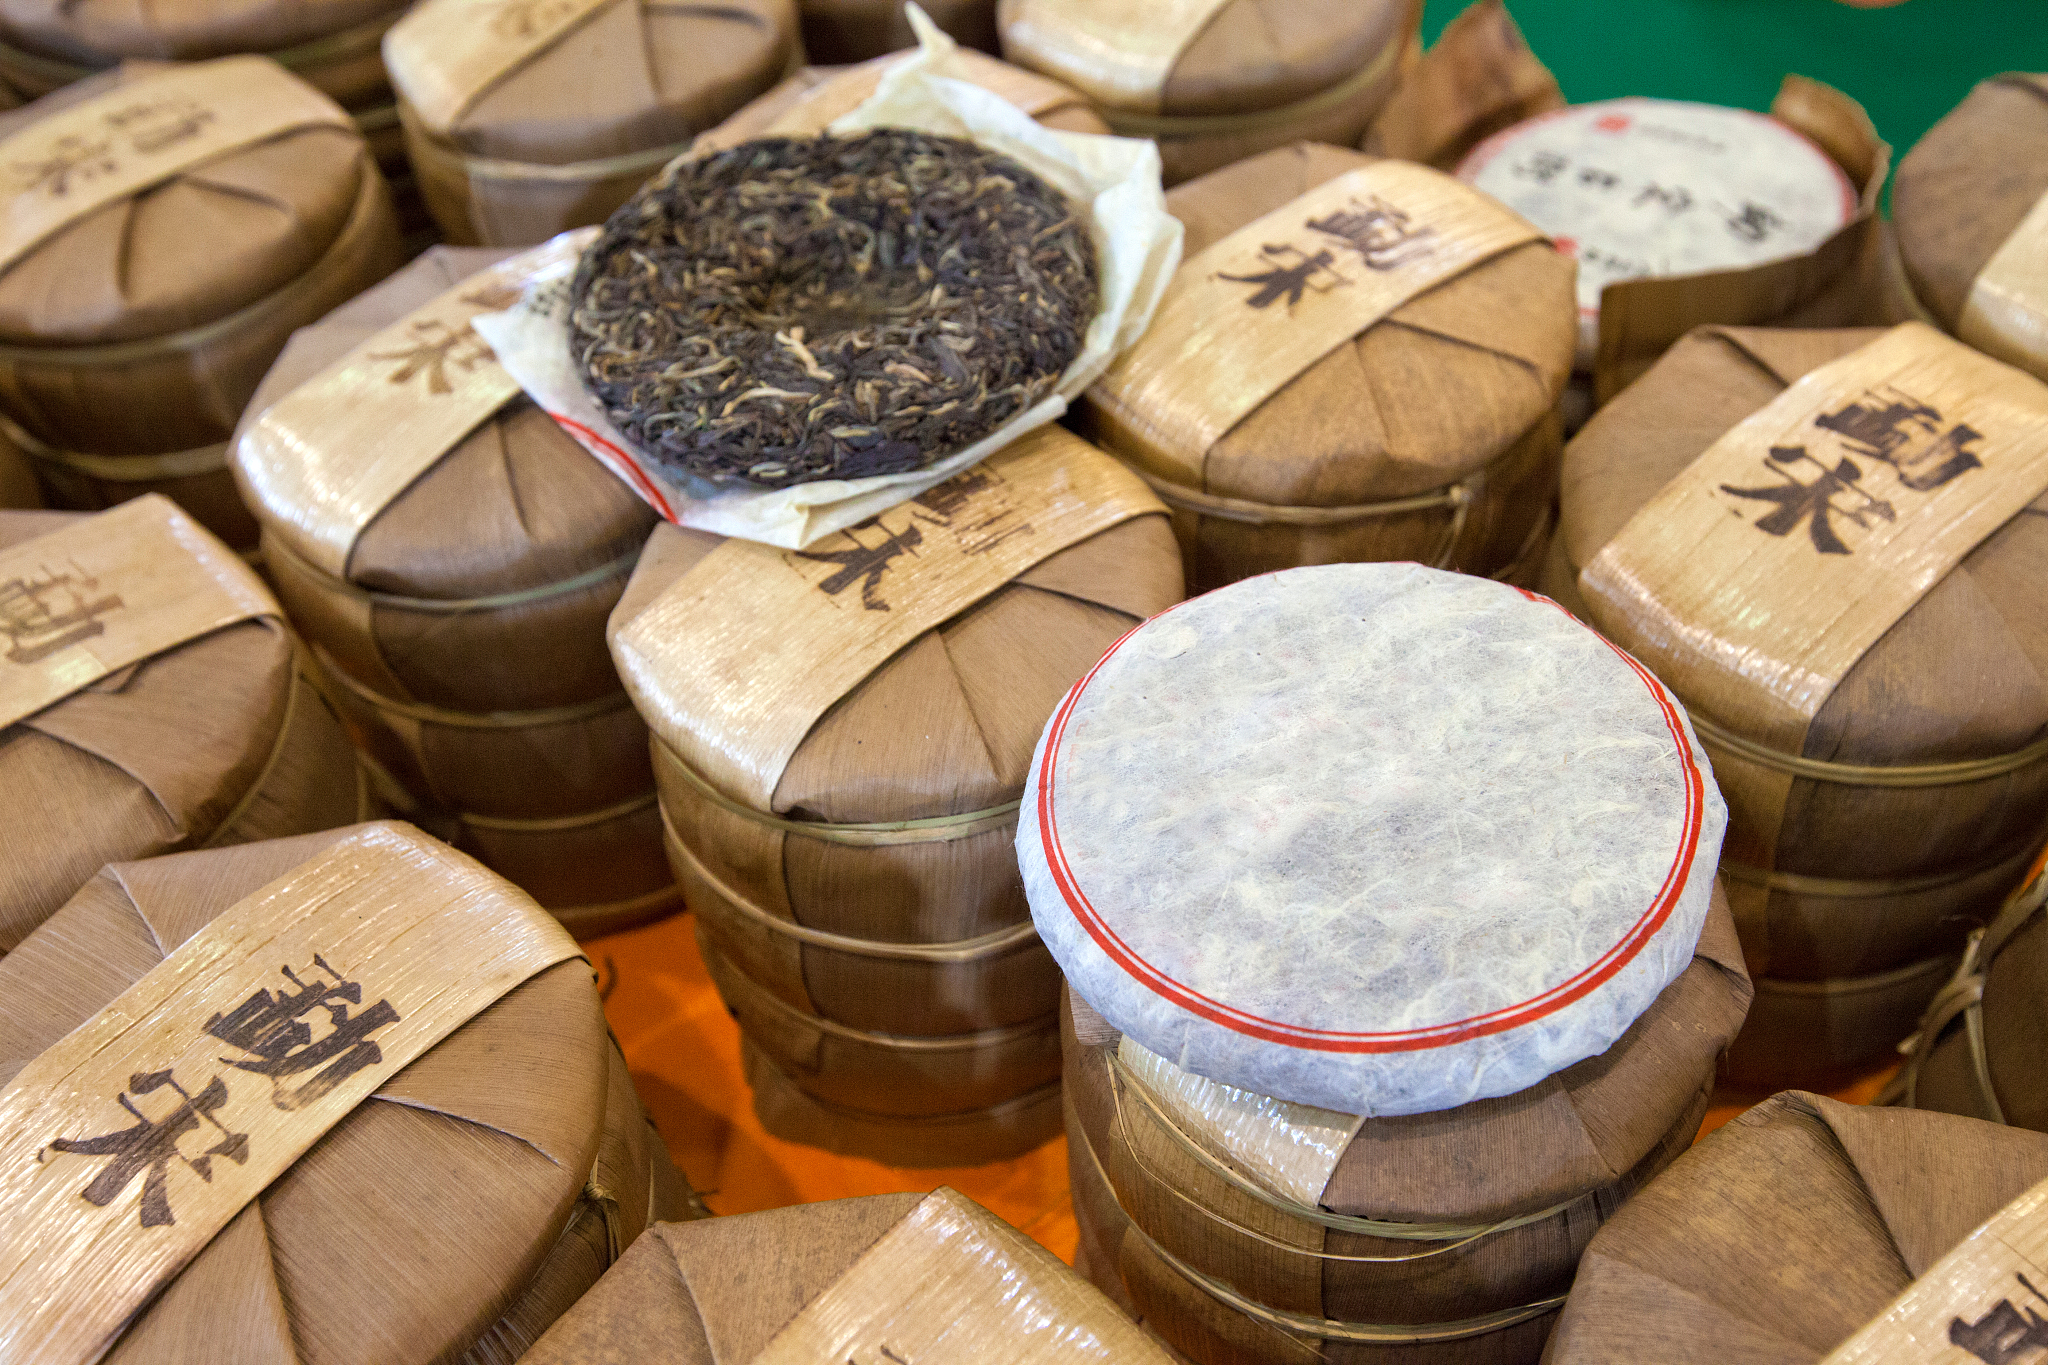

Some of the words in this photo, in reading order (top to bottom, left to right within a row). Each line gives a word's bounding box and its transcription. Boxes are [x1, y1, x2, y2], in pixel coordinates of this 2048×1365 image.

[1207, 194, 1440, 319] 勐宋
[1717, 385, 1985, 556] 勐宋
[37, 952, 401, 1229] 勐宋
